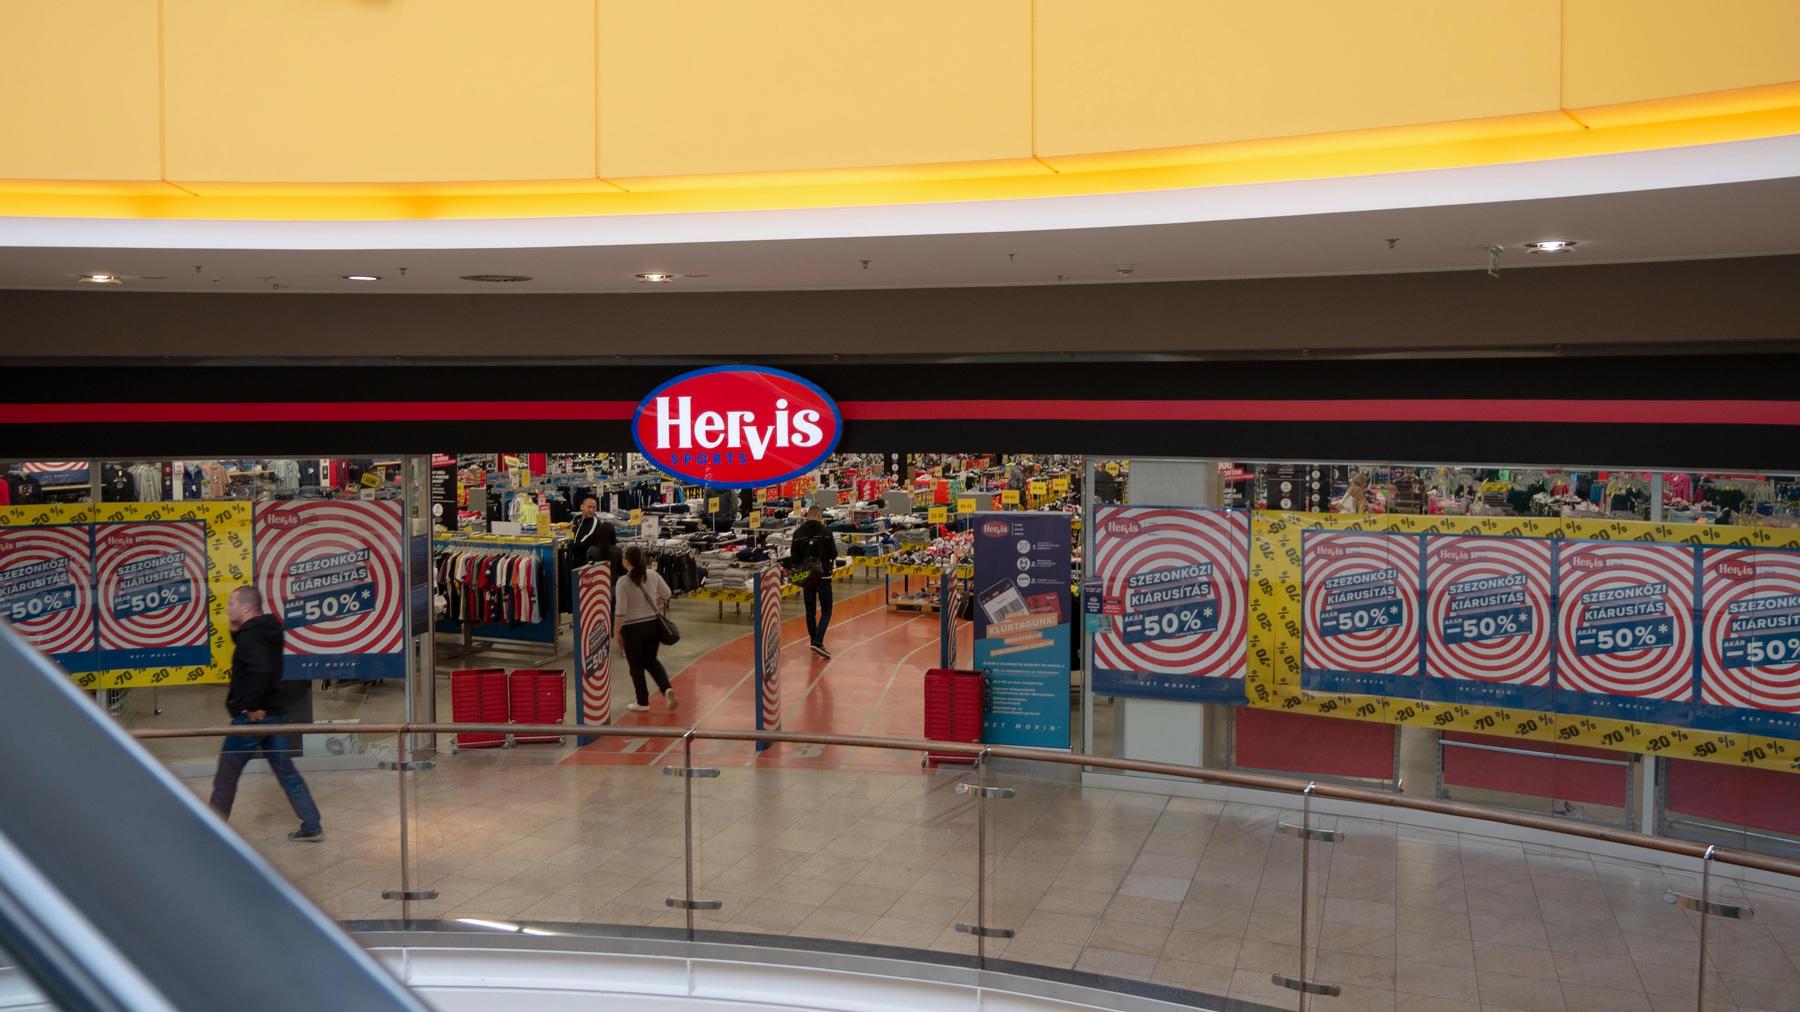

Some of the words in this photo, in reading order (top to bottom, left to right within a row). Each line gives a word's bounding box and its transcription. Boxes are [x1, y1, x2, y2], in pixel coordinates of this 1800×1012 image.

[656, 396, 824, 460] Hervis
[671, 453, 747, 465] SPORTS
[267, 513, 298, 526] Hervis
[1108, 521, 1139, 534] Hervis
[983, 523, 1008, 535] Hervis
[117, 552, 185, 575] SZEZONKÖZI
[289, 550, 369, 575] SZEZONKÖZI
[1440, 549, 1468, 561] Hervis
[1573, 556, 1603, 569] Hervis
[120, 567, 183, 590] KIÁRUSÍTÁS
[1129, 564, 1211, 587] SZEZONKÖZI
[1325, 569, 1397, 588] SZEZONKÖZI
[1719, 563, 1752, 576] Hervis
[292, 568, 367, 592] KIÁRUSÍTÁS
[1450, 575, 1526, 594] SZEZONKÖZI
[1131, 584, 1209, 606] KIÁRUSÍTÁS
[1327, 586, 1395, 604] KIÁRUSÍTÁS
[1451, 592, 1523, 610] KIÁRUSÍTÁS
[1582, 583, 1666, 604] SZEZONKÖZI
[285, 600, 304, 609] AKÁR
[1584, 602, 1664, 621] KIÁRUSÍTÁS
[1729, 595, 1800, 613] SZEZONK
[1124, 614, 1143, 622] AKÁR
